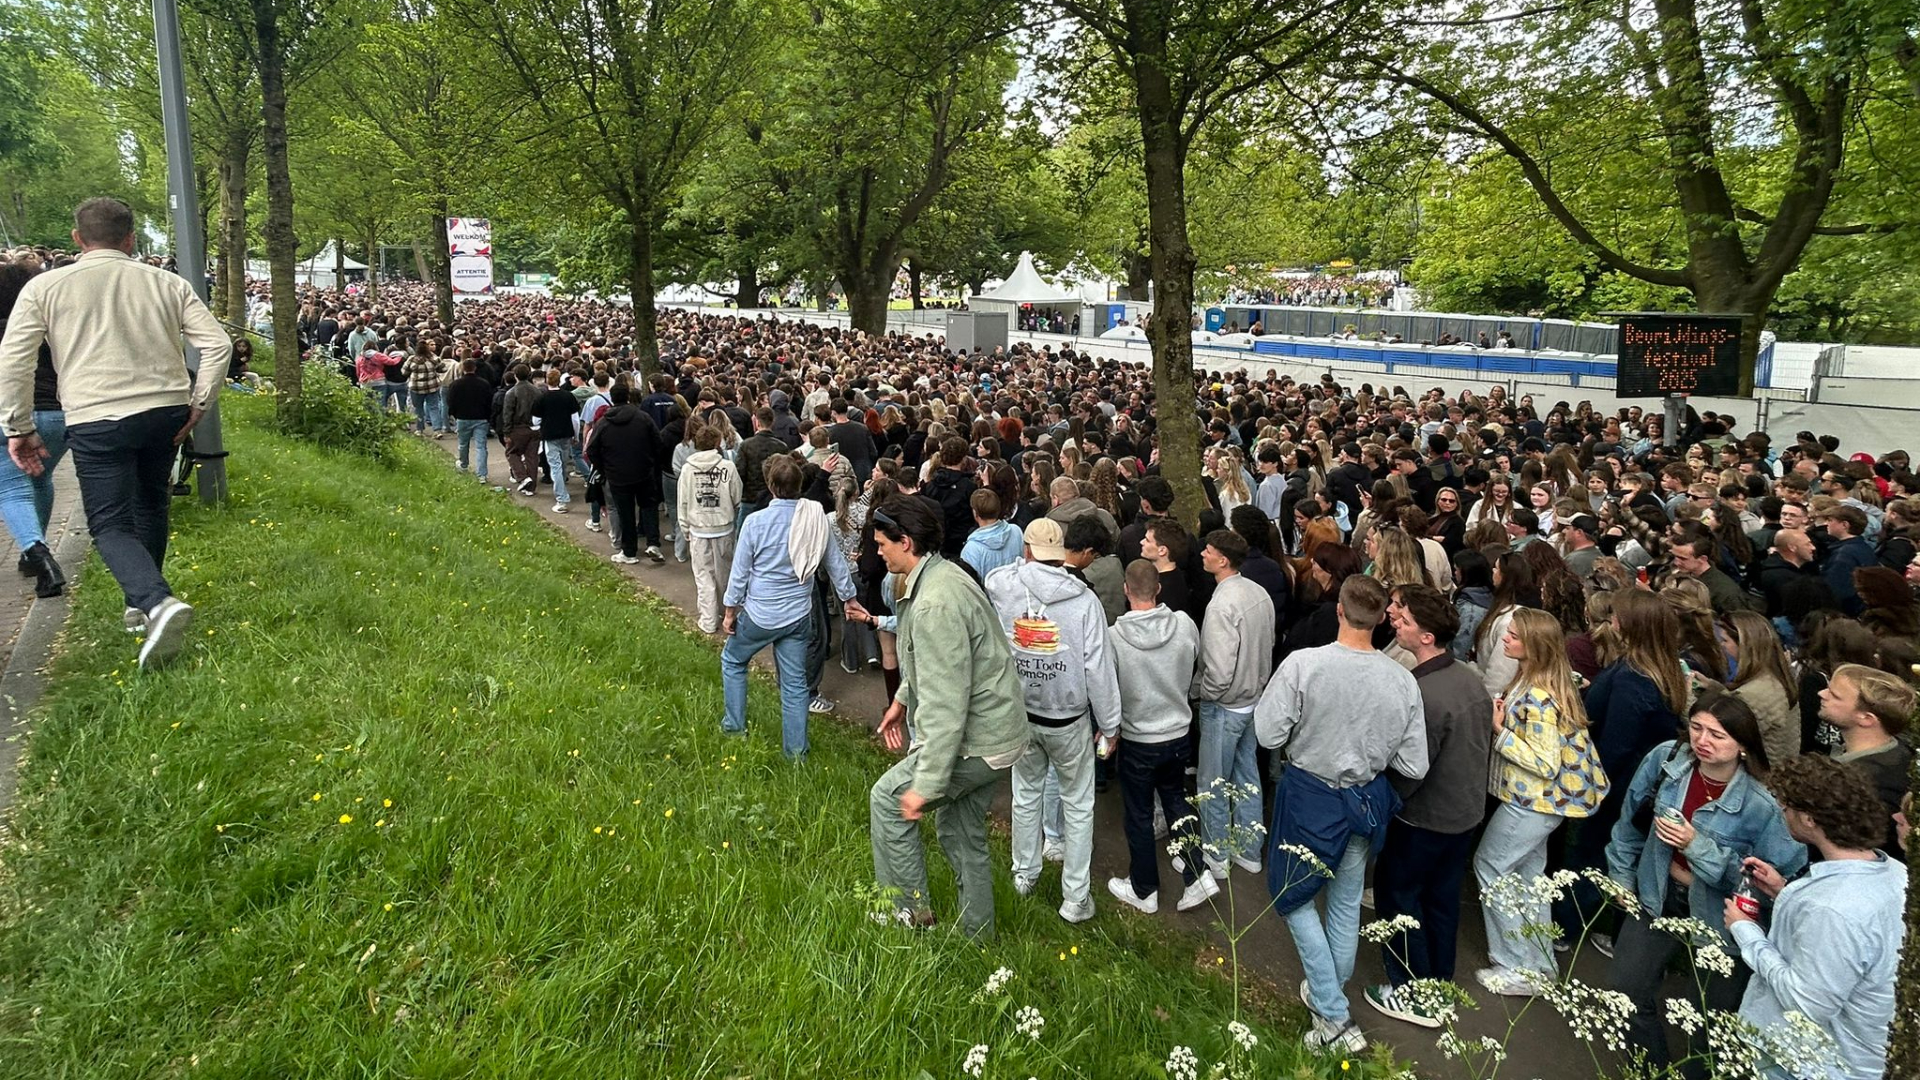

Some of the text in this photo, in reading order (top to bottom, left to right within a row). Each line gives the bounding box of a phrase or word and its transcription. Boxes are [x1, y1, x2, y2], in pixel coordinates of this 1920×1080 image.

[1625, 323, 1736, 344] Bevrijdings-
[1644, 346, 1716, 367] festival
[1659, 369, 1698, 389] 2025
[1032, 658, 1067, 672] Tooth
